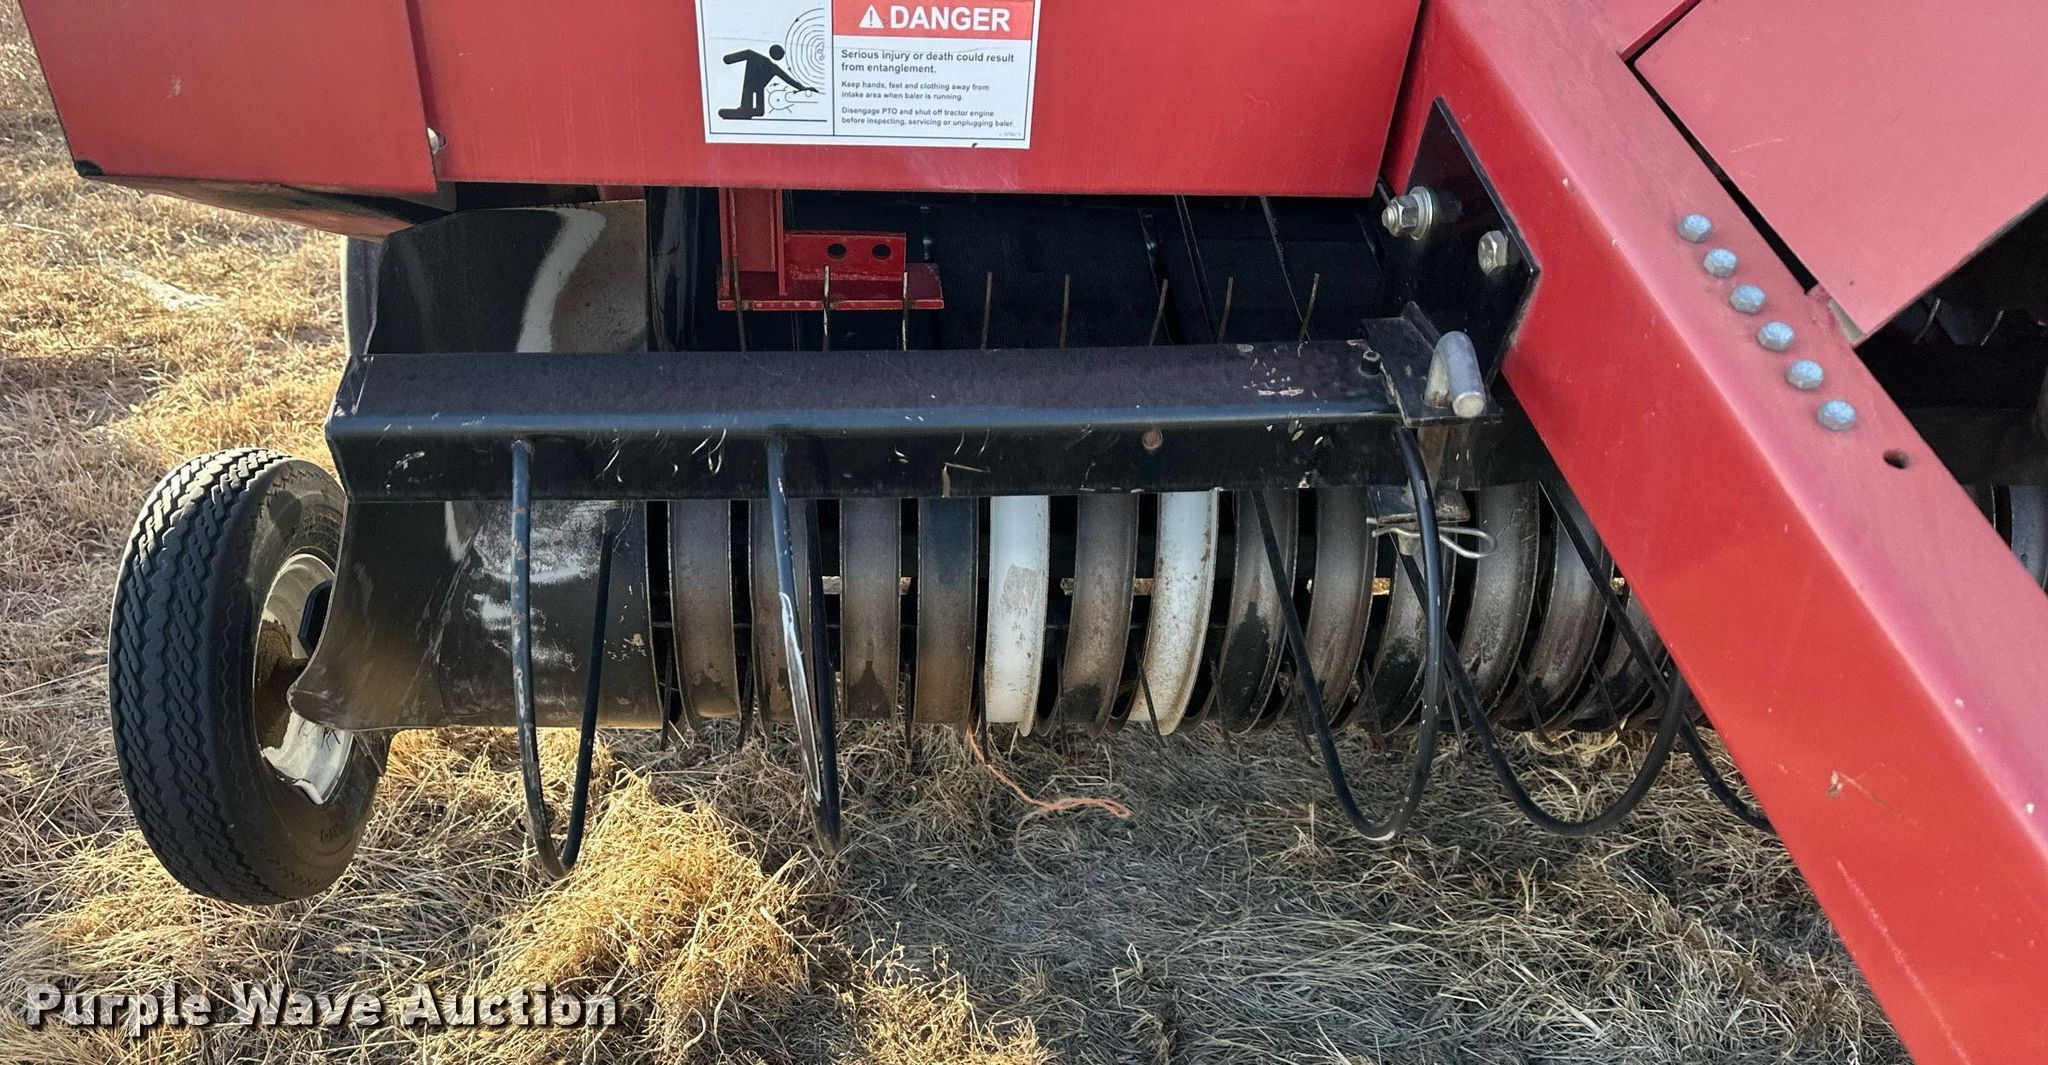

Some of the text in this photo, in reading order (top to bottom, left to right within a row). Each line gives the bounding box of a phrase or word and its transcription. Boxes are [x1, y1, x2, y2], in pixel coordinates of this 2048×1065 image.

[890, 6, 1011, 32] DANGER
[841, 50, 879, 59] Serious
[882, 50, 910, 62] injury
[926, 51, 953, 61] death
[956, 53, 983, 61] could
[987, 54, 1014, 62] result
[841, 63, 937, 74] from entanglement.
[842, 81, 860, 89] Keep
[920, 83, 950, 91] clothing
[842, 107, 880, 115] Disengage
[970, 110, 994, 118] engine
[867, 118, 907, 126] inspecting,
[909, 119, 941, 127] servicing
[953, 119, 993, 127] unplugging
